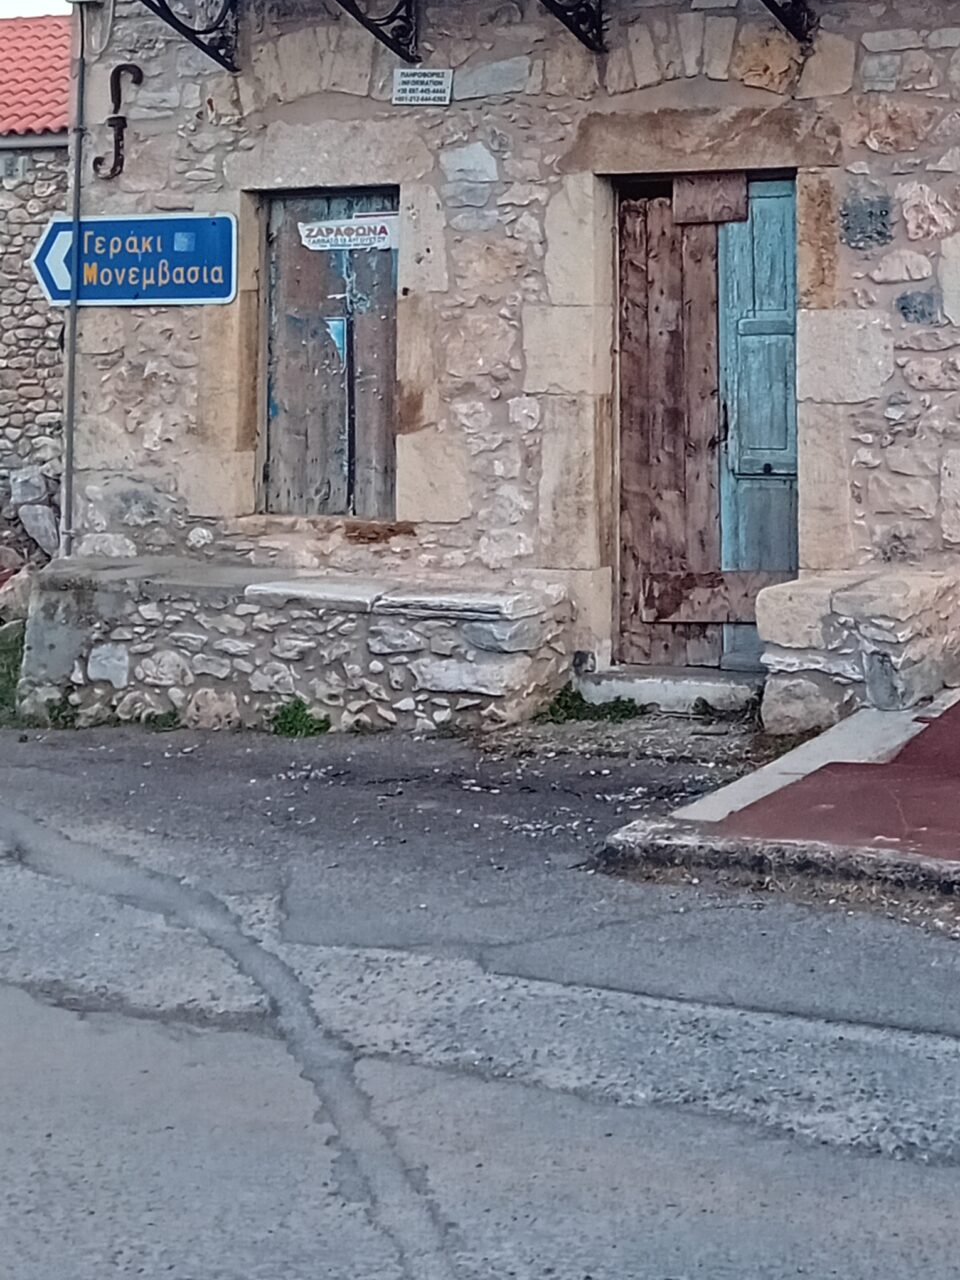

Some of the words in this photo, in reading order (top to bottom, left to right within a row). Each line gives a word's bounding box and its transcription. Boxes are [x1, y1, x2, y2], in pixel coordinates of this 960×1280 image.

[83, 230, 163, 259] Γεράκι
[305, 225, 388, 238] ΖΑΡΑΦΩΝΑ
[83, 259, 224, 291] Μονεμβασία
